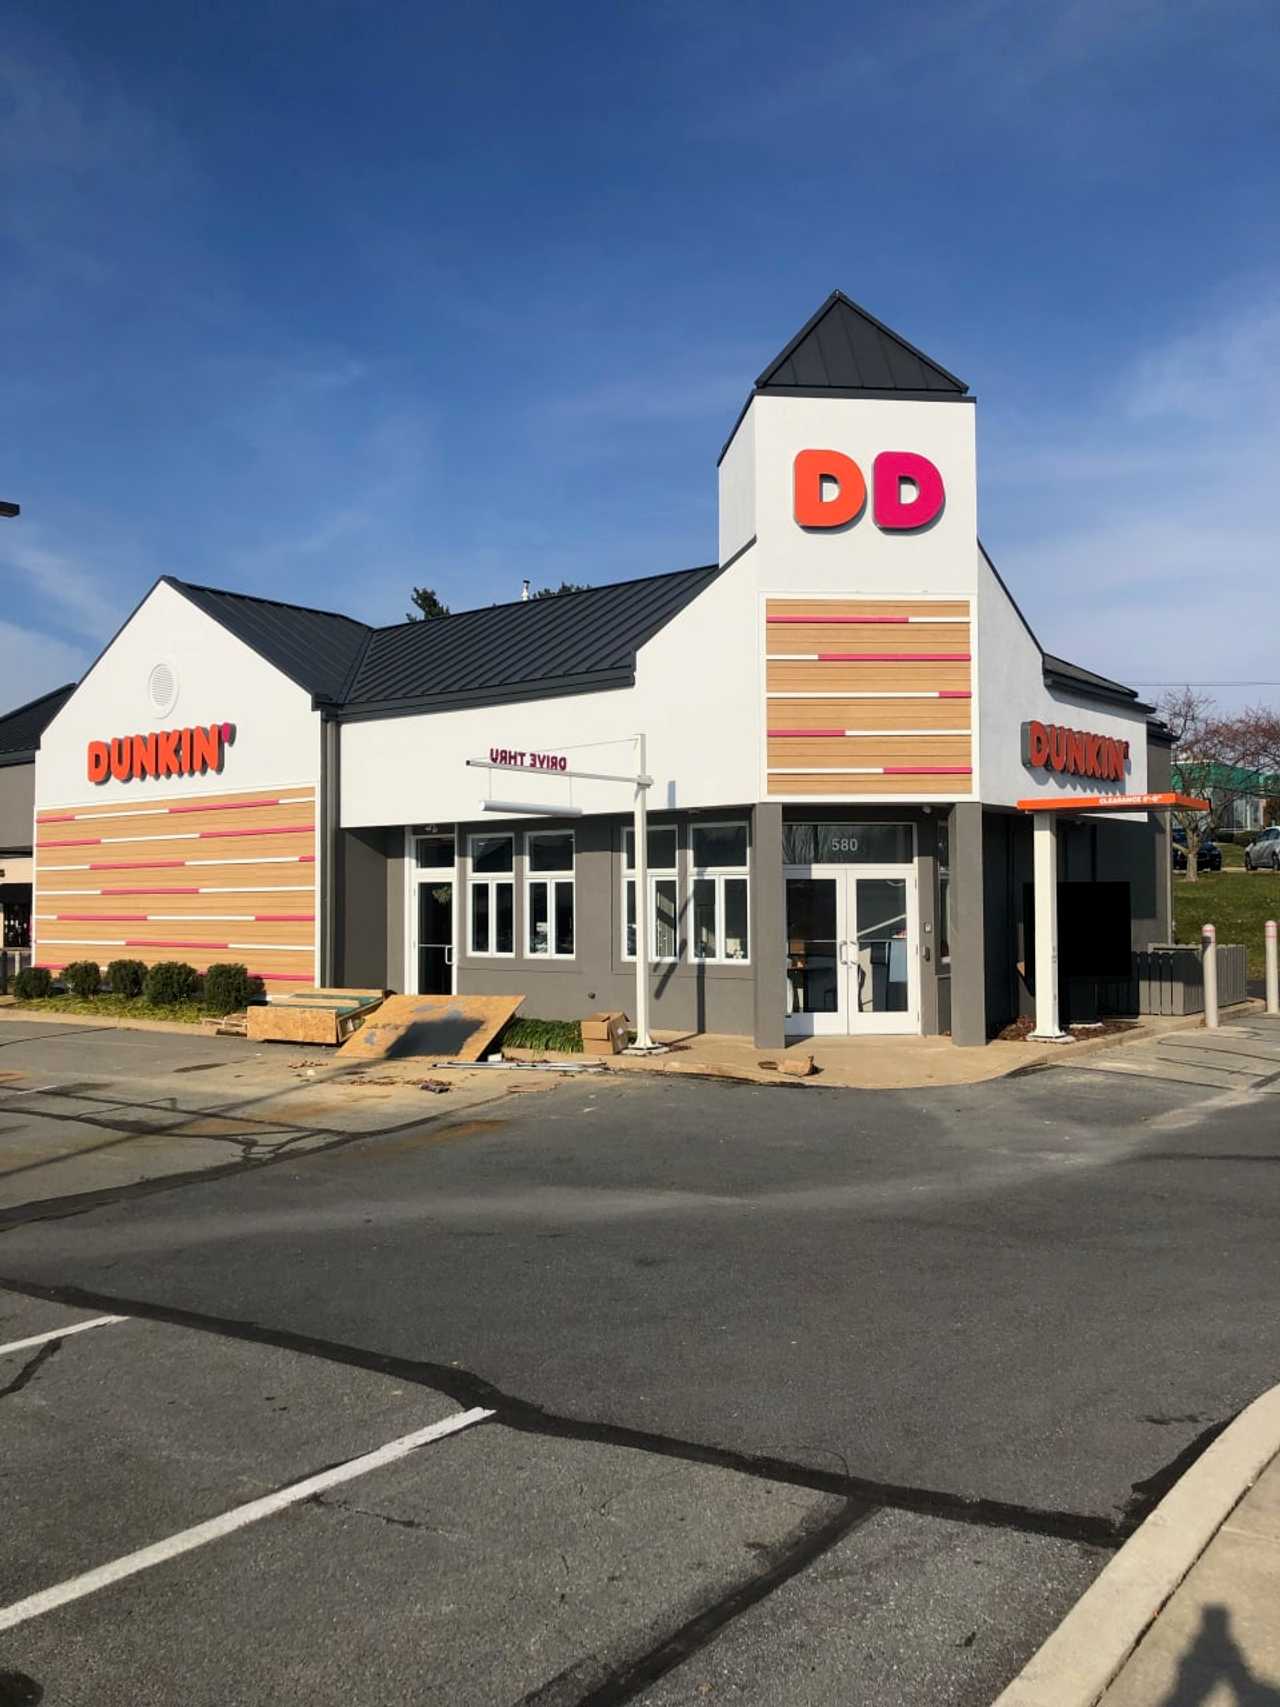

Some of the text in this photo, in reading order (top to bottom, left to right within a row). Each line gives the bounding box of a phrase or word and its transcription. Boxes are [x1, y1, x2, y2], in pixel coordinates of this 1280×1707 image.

[87, 722, 232, 783] DUNKIN'
[1022, 720, 1129, 781] DUNKIN'
[831, 838, 858, 851] 580
